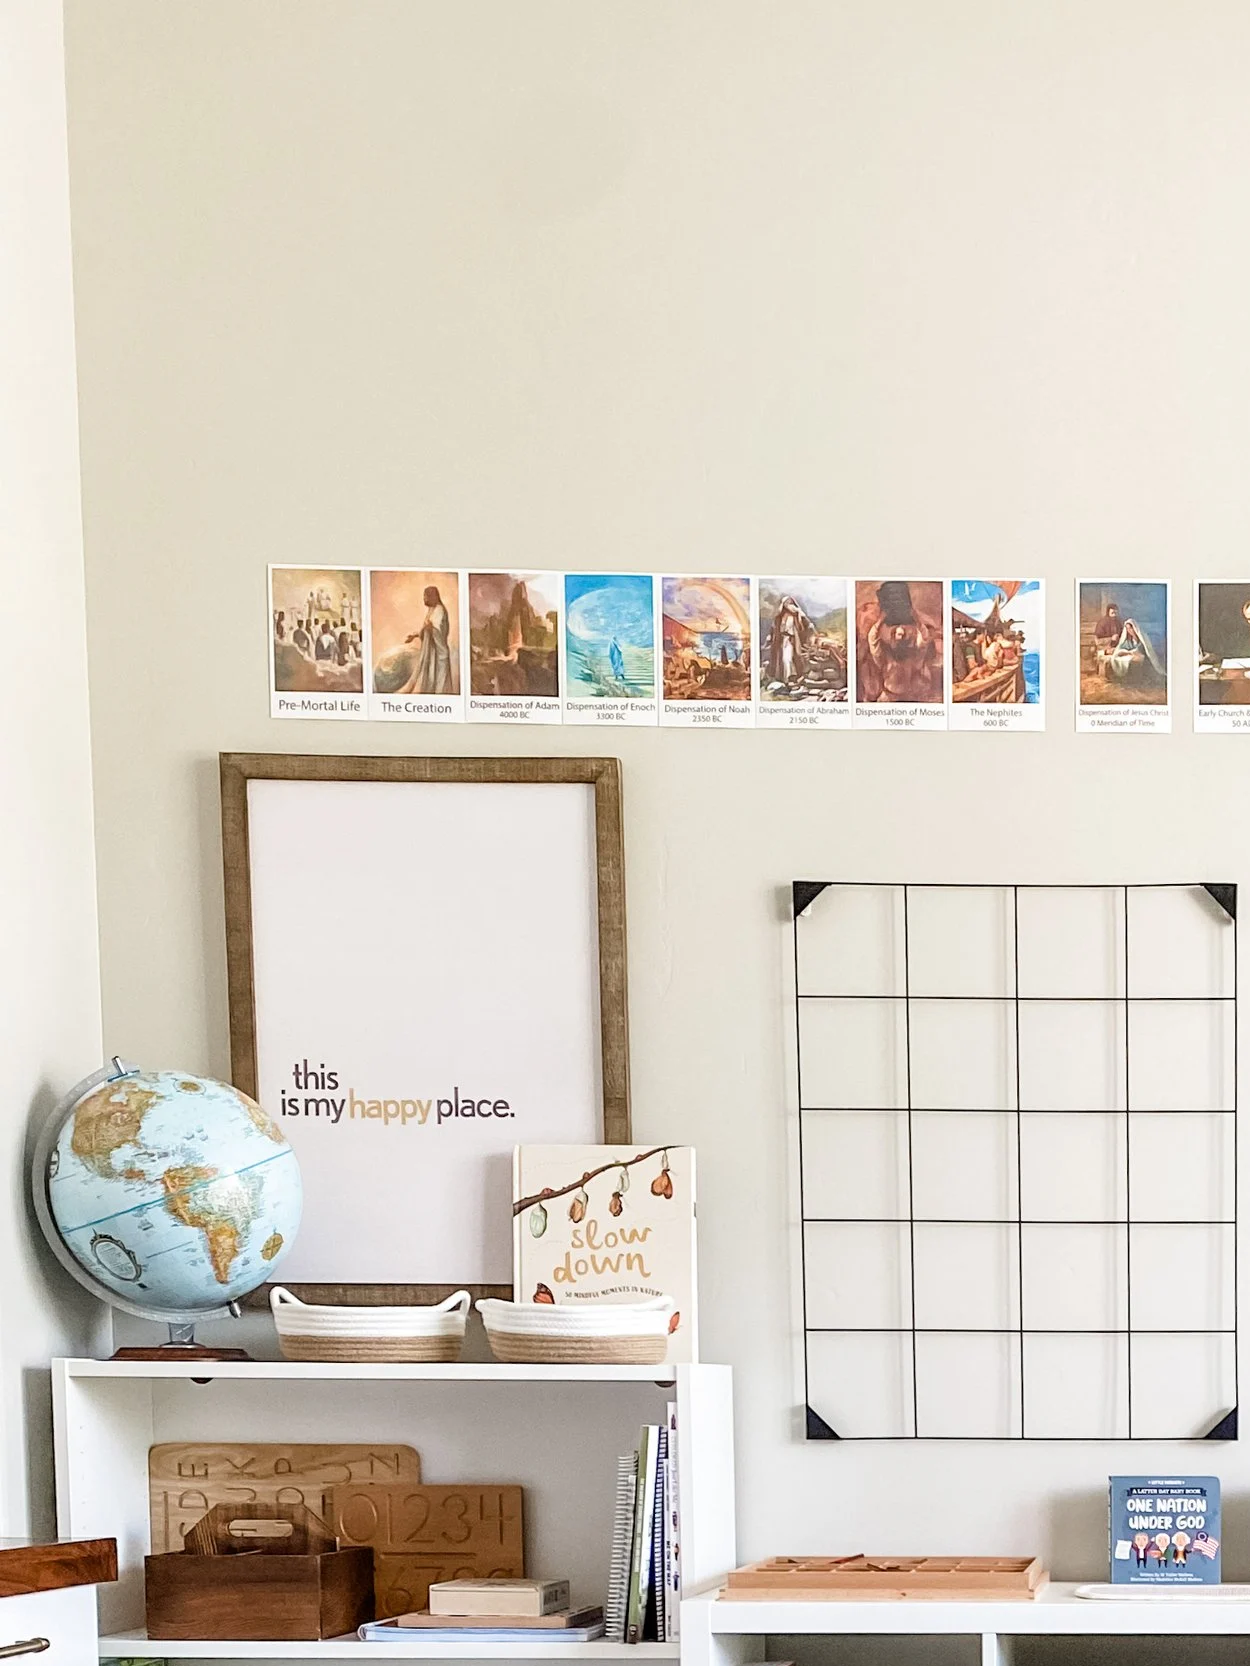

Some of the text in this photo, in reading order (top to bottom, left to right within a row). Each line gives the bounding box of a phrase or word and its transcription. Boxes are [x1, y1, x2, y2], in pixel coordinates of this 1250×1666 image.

[279, 699, 361, 712] Pre-Mortal Life
[381, 701, 452, 714] The Creation
[470, 701, 560, 711] Dispensation of Adam
[566, 703, 656, 712] Dispensation of Enoch
[664, 705, 751, 714] Dispensation of Noah
[499, 711, 530, 719] 4000 BC
[856, 708, 945, 717] Dispensation of Moses
[970, 708, 1023, 718] The Nephites
[1198, 710, 1216, 719] Early
[1218, 710, 1244, 719] Church
[886, 718, 915, 726] 1500 BC
[983, 719, 1009, 727] 600 BC
[1232, 719, 1241, 727] 50
[292, 1059, 340, 1091] this
[281, 1087, 515, 1126] is my happy place.
[571, 1219, 653, 1250] slow
[553, 1252, 652, 1283] down
[601, 1286, 630, 1297] MOMENTS
[1126, 1498, 1207, 1513] ONE NATION
[1128, 1515, 1205, 1530] UNDER GOD
